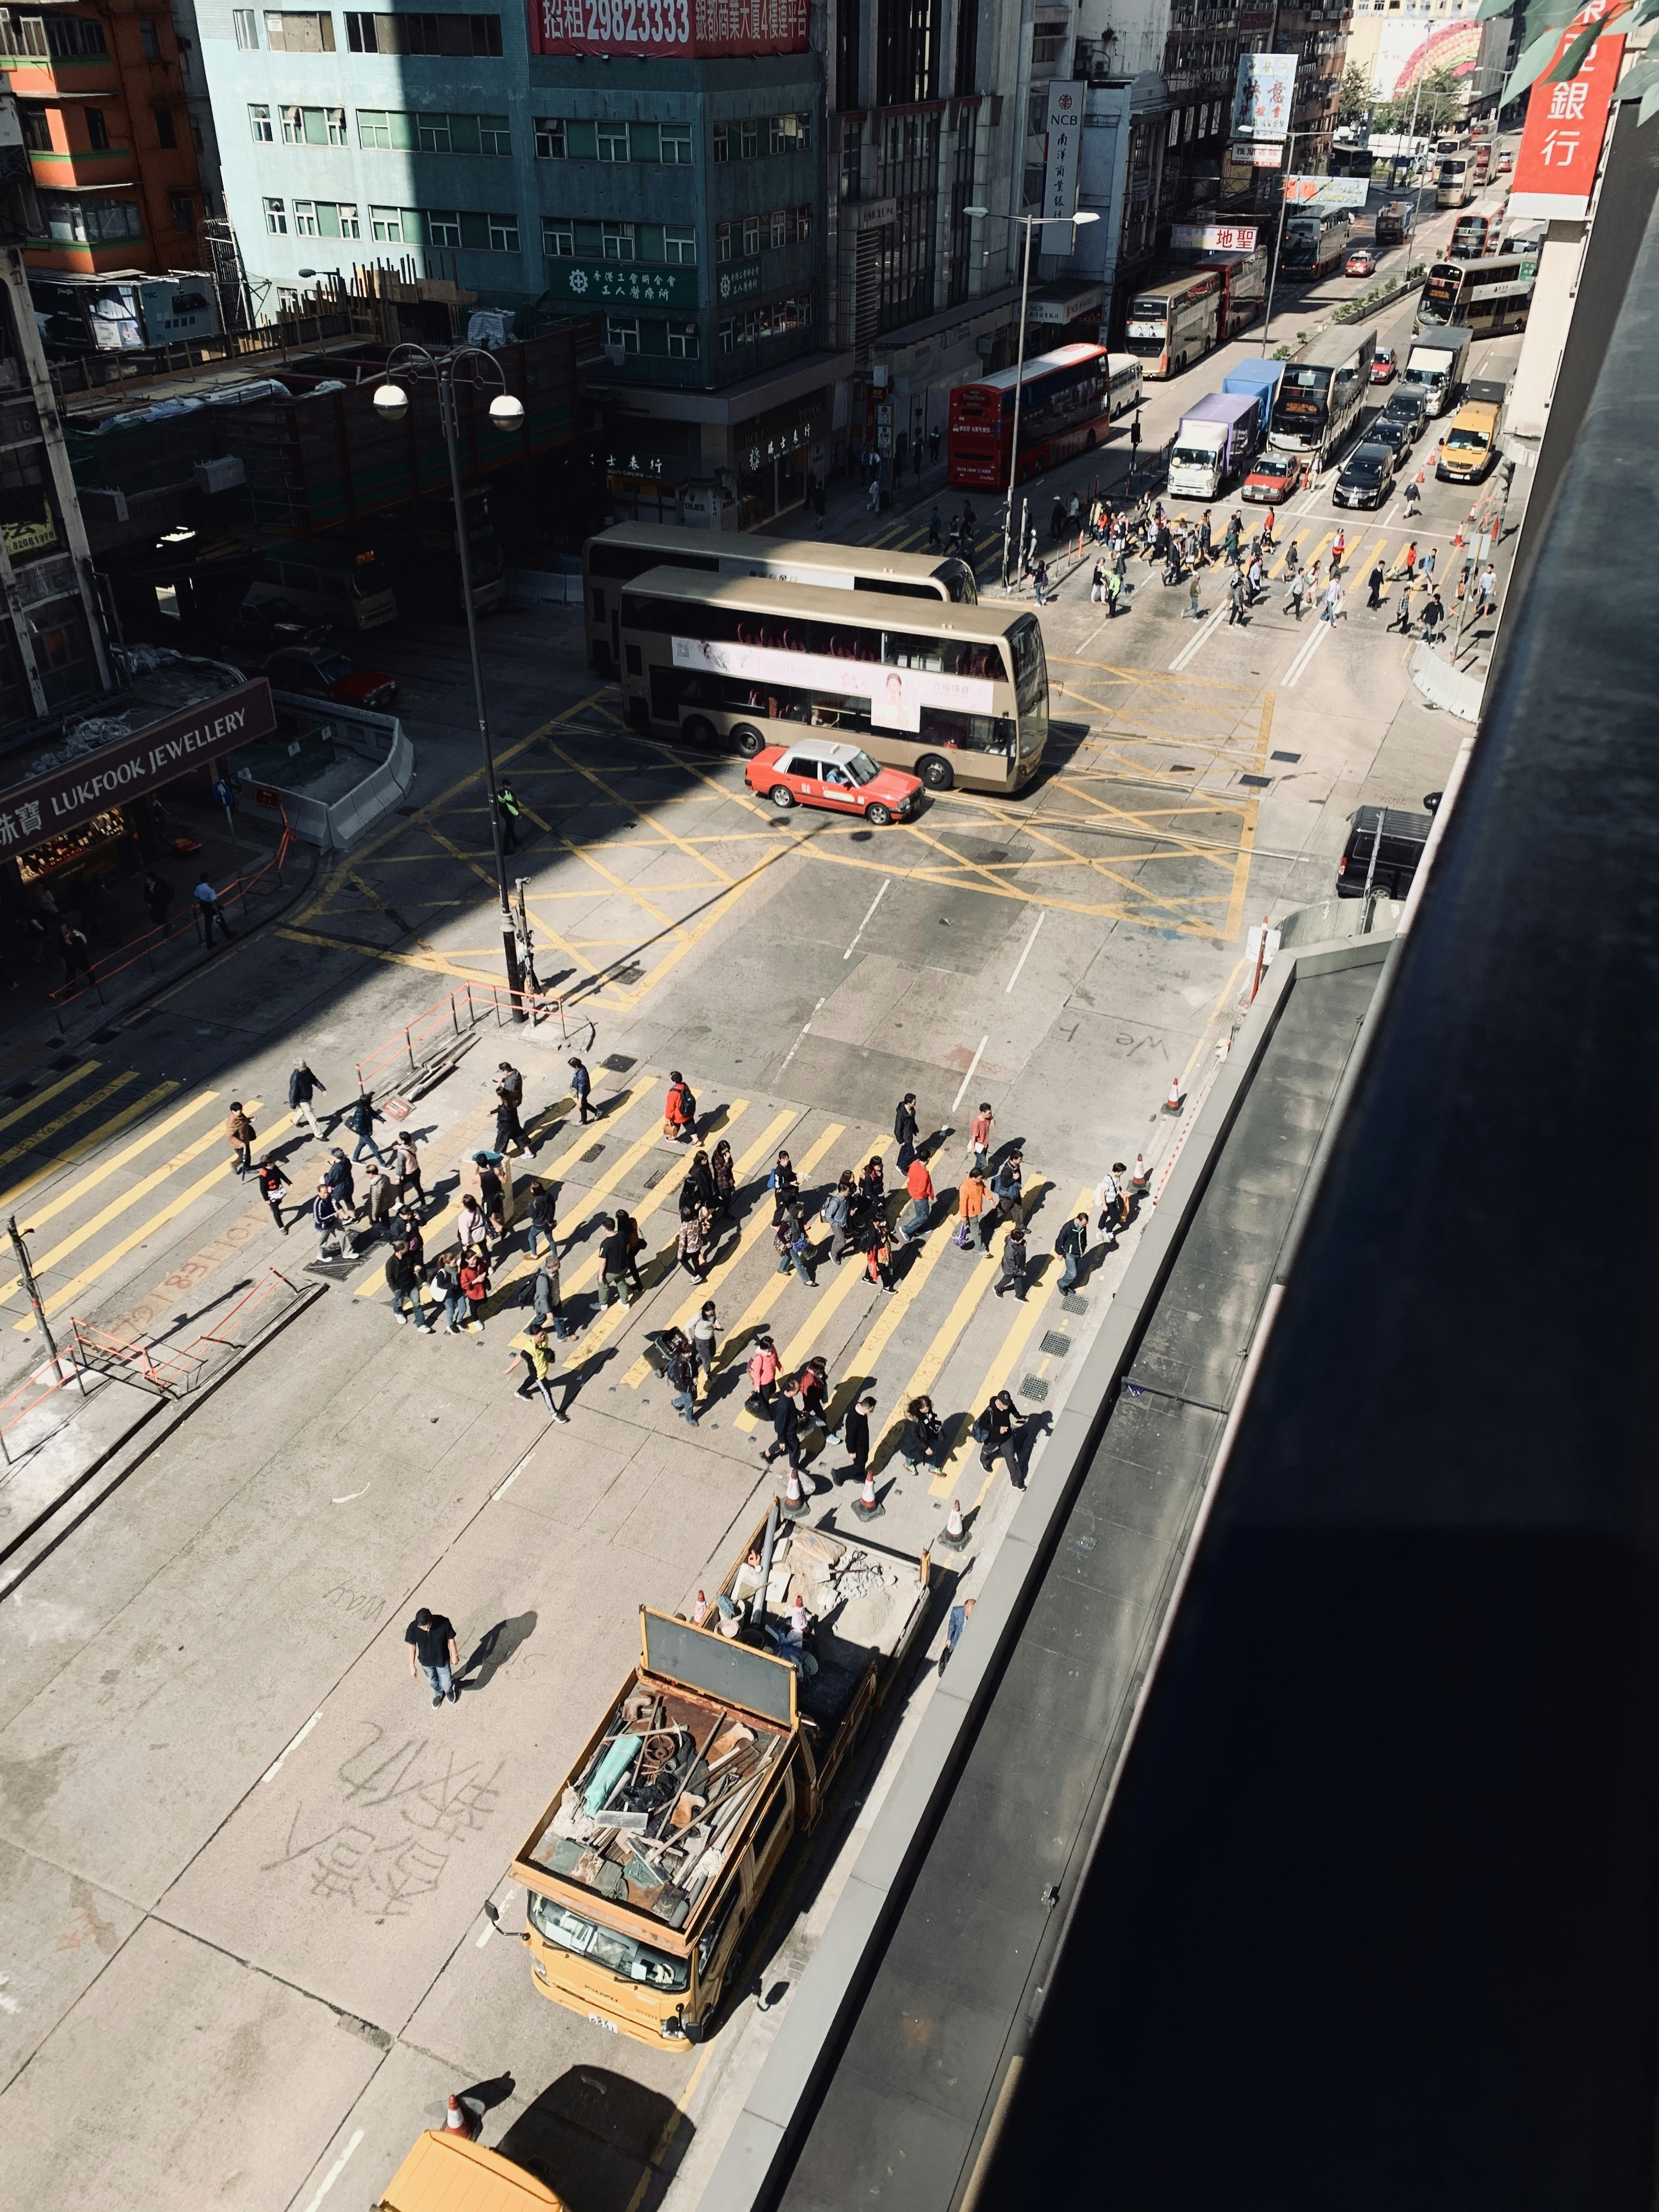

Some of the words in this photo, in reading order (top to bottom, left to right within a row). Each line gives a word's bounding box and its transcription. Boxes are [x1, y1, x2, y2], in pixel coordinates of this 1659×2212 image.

[543, 0, 585, 39] 招租
[587, 0, 689, 43] 29823333
[1051, 114, 1077, 126] NCB
[1053, 133, 1068, 219] 南洋商業銀行
[799, 403, 822, 422] TUDOR
[623, 470, 644, 478] Company
[685, 503, 706, 512] OLEX
[51, 757, 145, 816] LUKFOOK
[149, 708, 245, 775] JEWELLERY
